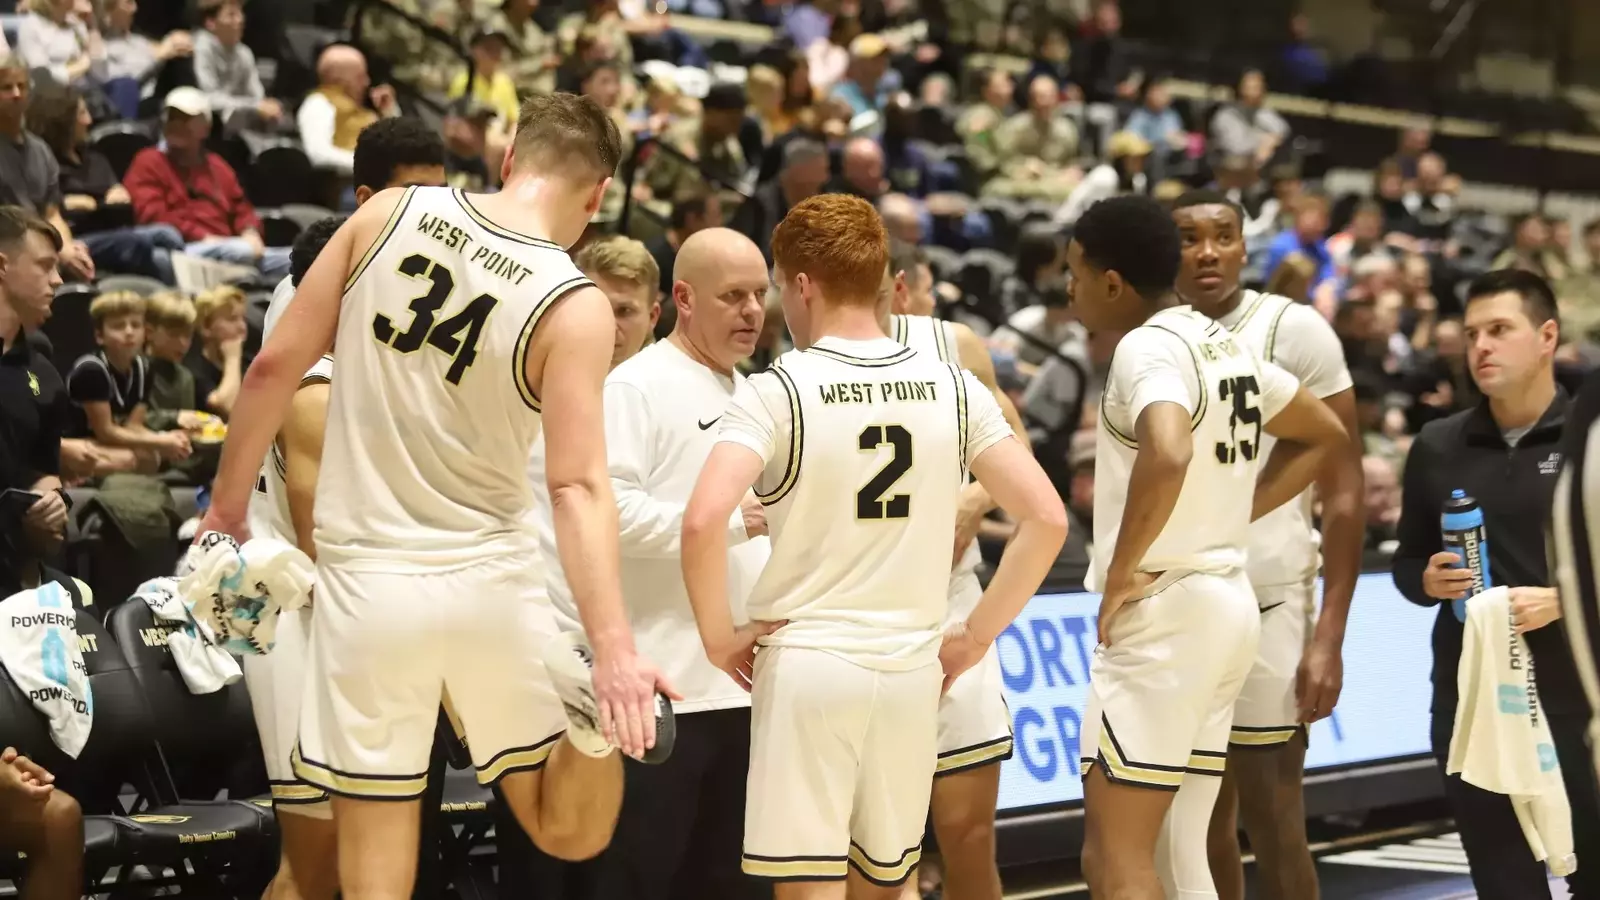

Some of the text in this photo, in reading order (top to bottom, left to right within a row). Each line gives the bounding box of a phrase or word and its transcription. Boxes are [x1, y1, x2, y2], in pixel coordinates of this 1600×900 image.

[416, 212, 534, 286] WEST POINT
[372, 252, 499, 387] 34
[818, 381, 937, 404] WEST POINT
[1214, 374, 1262, 464] 35
[856, 423, 914, 520] 2
